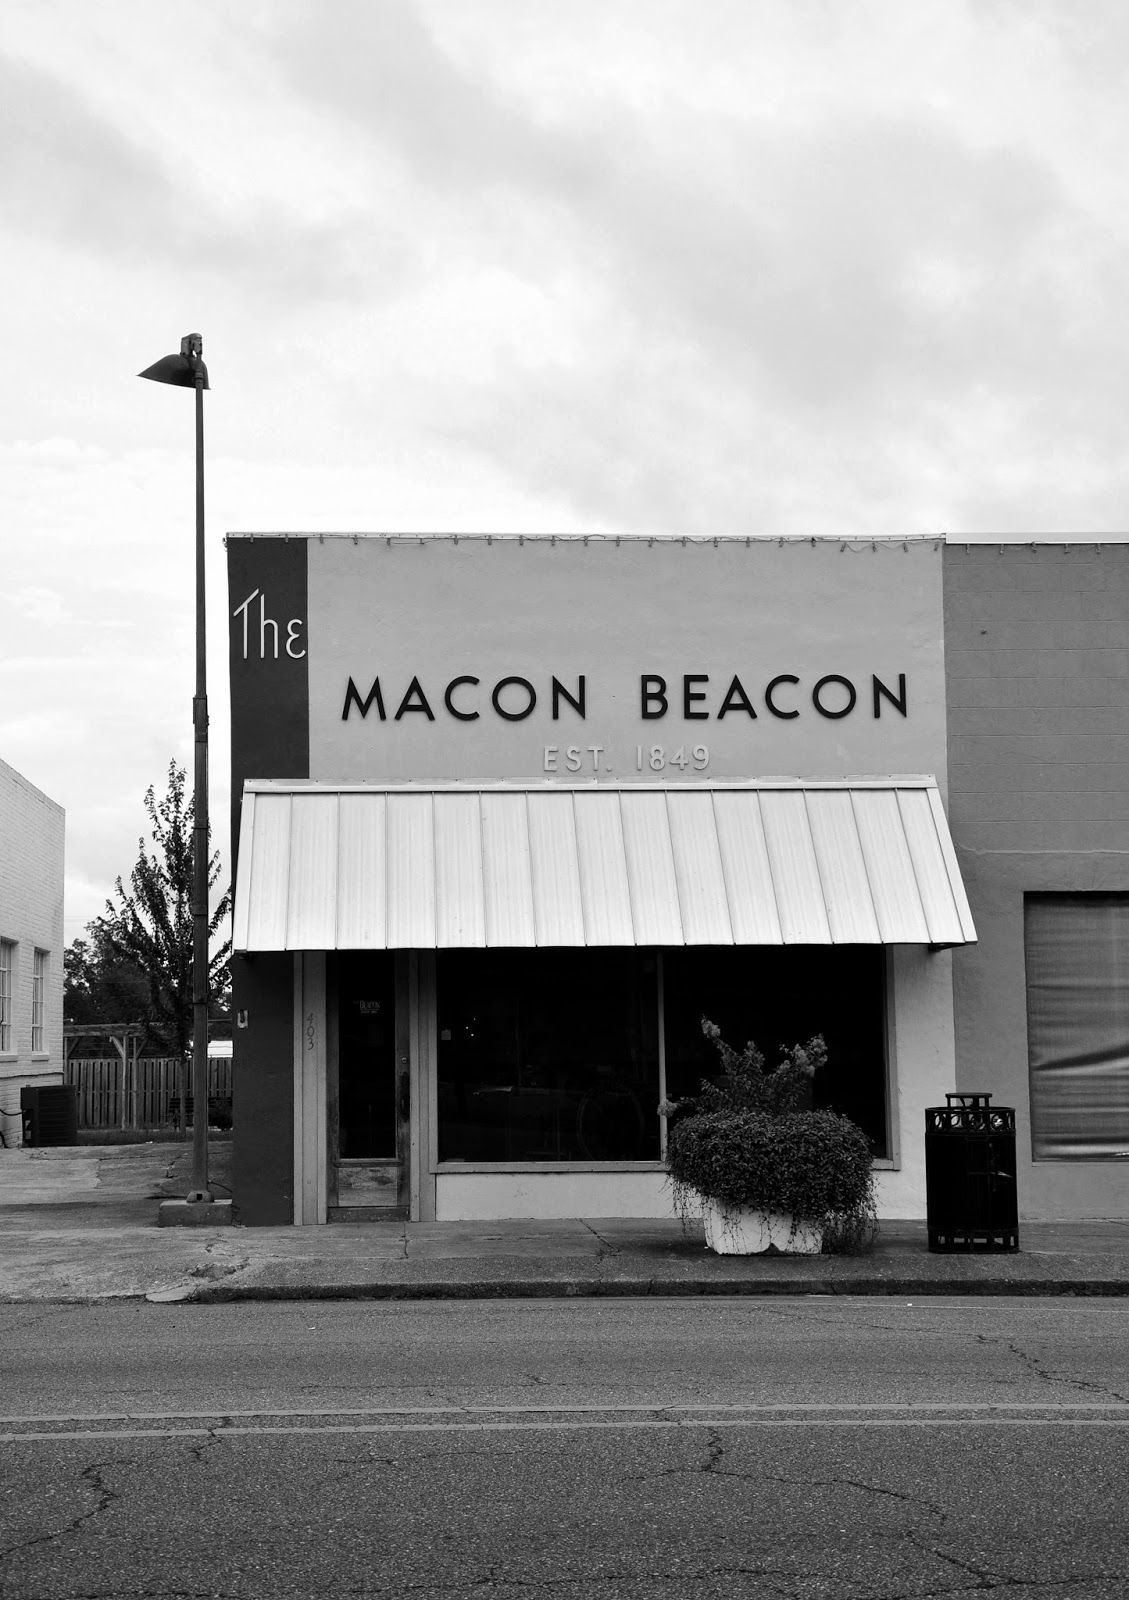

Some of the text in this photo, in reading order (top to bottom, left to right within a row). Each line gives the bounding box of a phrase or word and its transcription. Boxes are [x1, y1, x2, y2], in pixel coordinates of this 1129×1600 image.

[232, 587, 307, 660] The
[341, 673, 908, 722] MACON BEACON
[543, 745, 710, 772] EST. 1849
[306, 1012, 315, 1051] 403
